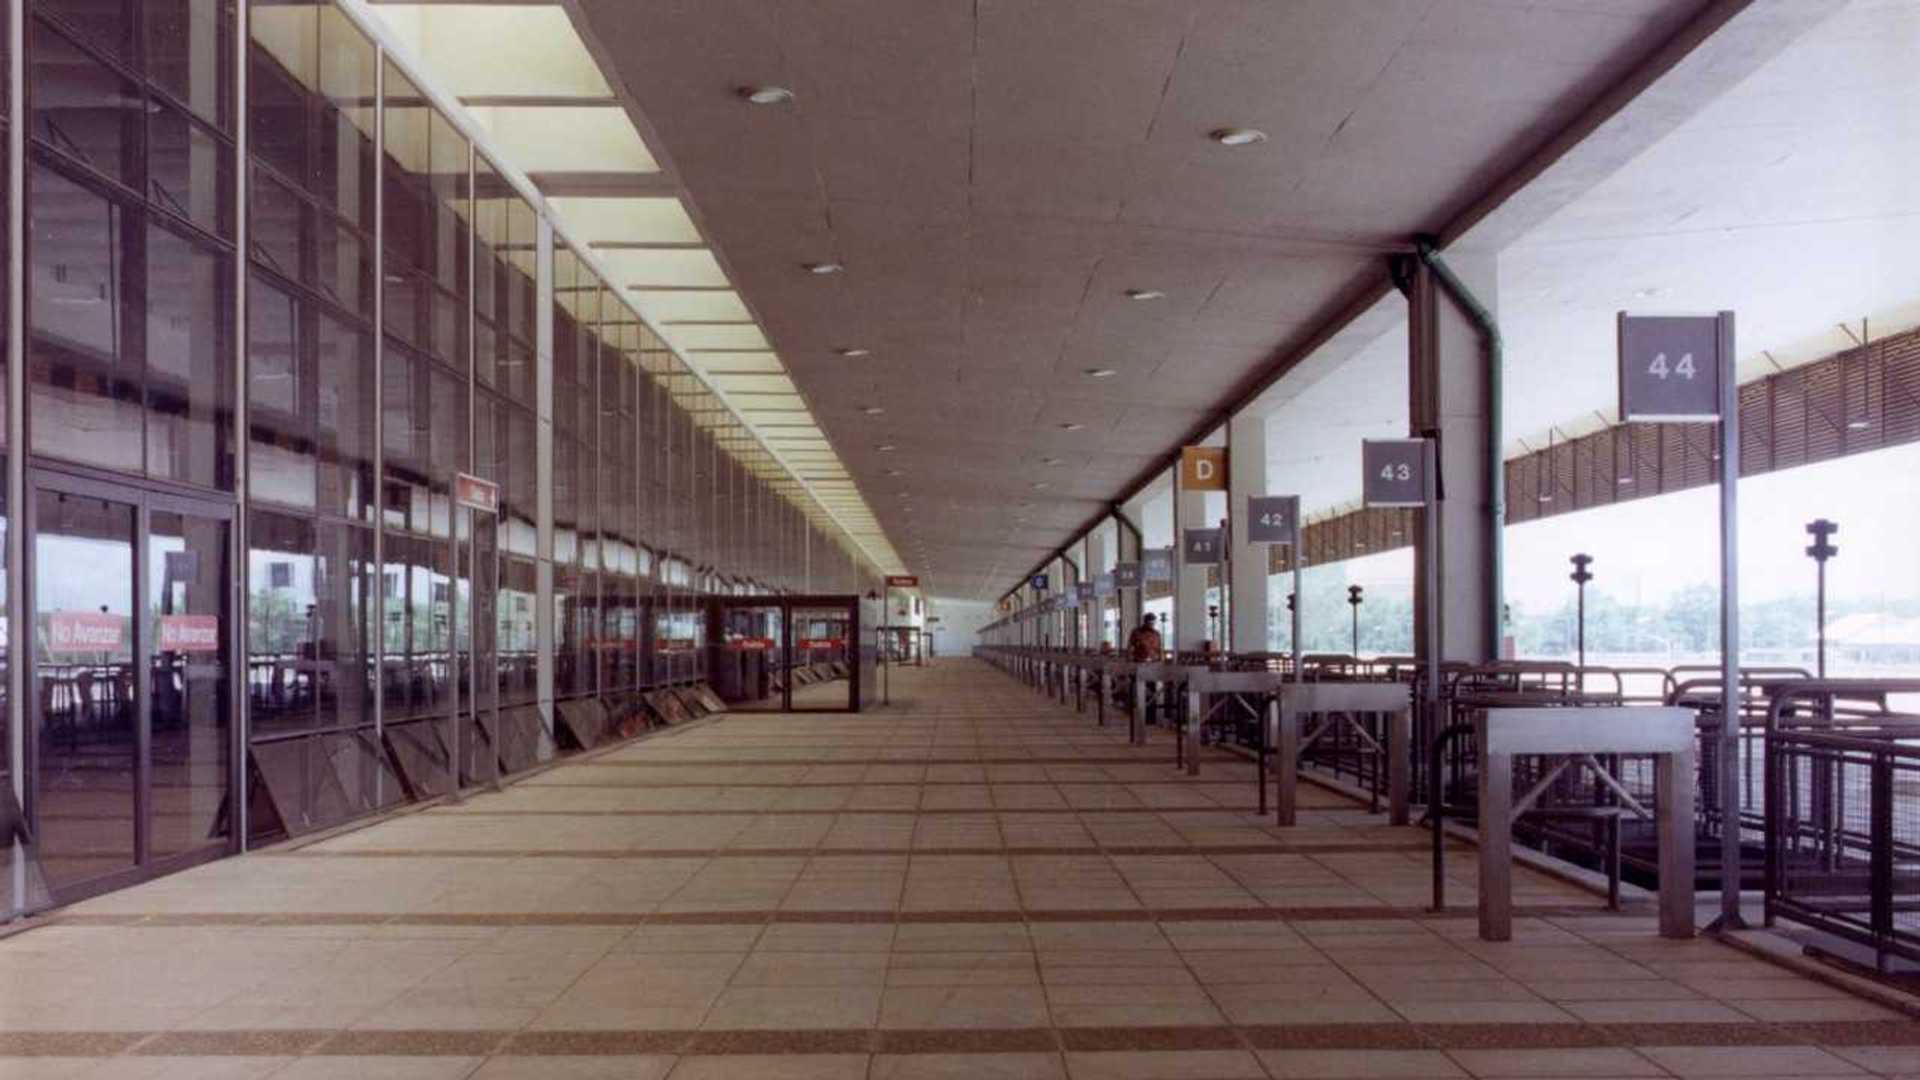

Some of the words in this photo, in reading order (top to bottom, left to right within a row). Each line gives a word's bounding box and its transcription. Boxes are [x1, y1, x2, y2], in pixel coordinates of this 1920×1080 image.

[1649, 352, 1696, 380] 44
[1196, 459, 1213, 480] D
[1381, 464, 1410, 480] 43
[1260, 513, 1283, 527] 42
[52, 622, 71, 643] No
